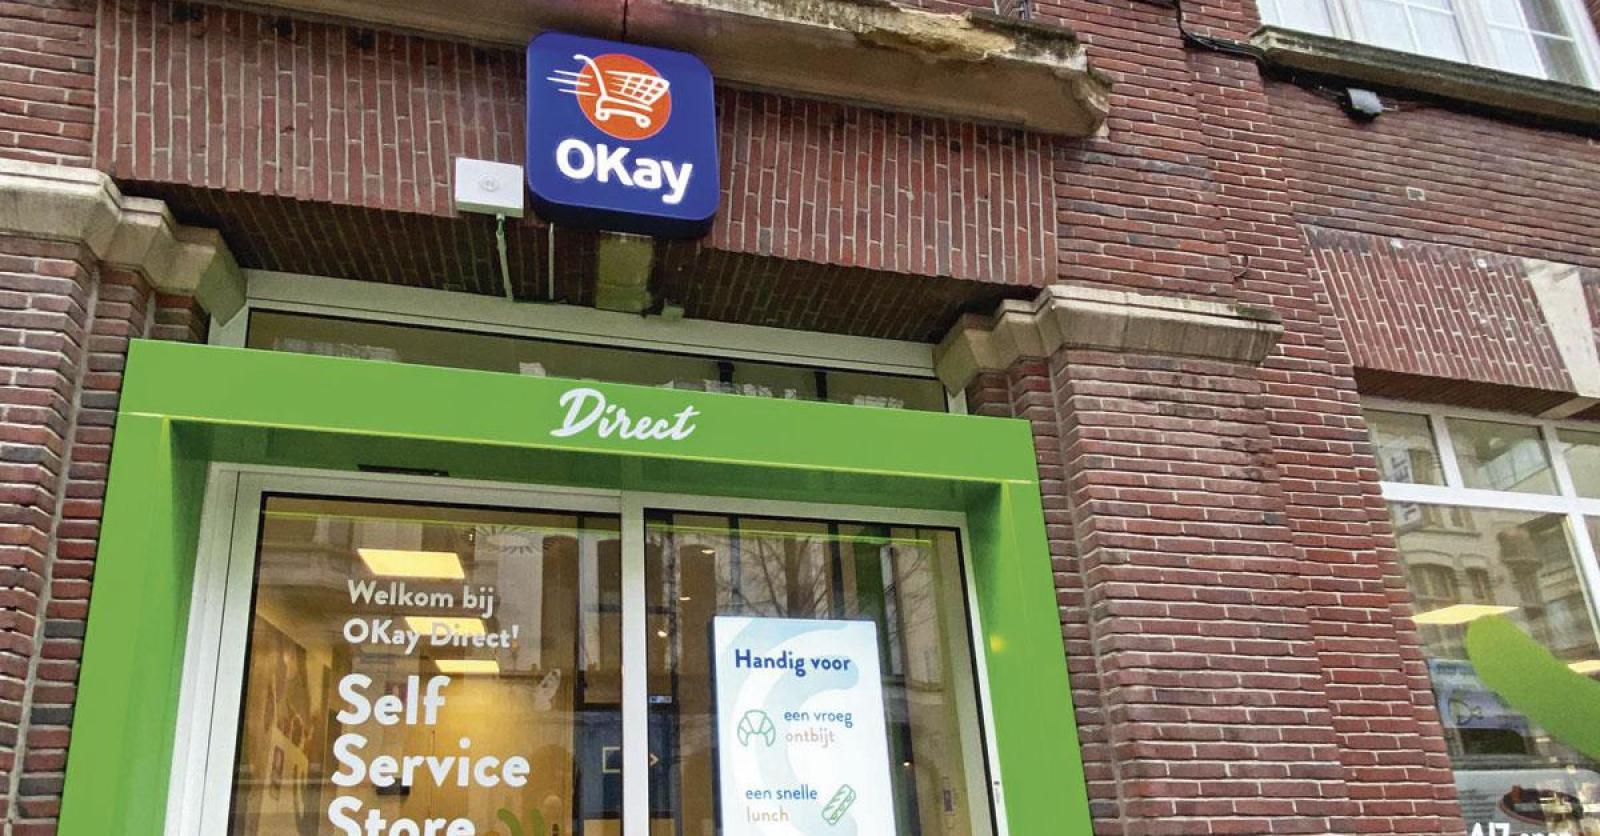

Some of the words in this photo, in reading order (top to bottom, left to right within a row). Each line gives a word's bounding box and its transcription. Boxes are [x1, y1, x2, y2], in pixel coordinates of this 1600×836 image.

[556, 138, 693, 204] OKay
[550, 388, 701, 441] Direct
[347, 579, 453, 607] Welkom
[463, 585, 494, 618] bij
[343, 618, 420, 654] OKay
[735, 649, 806, 677] Handig
[811, 658, 850, 671] voor
[336, 673, 451, 725] Self
[784, 710, 809, 721] een
[815, 711, 853, 728] vroeg
[785, 729, 835, 748] ontbijt
[331, 733, 530, 788] Service
[745, 790, 772, 800] een
[776, 784, 818, 800] snelle
[328, 796, 476, 836] Store
[746, 806, 790, 823] lunch
